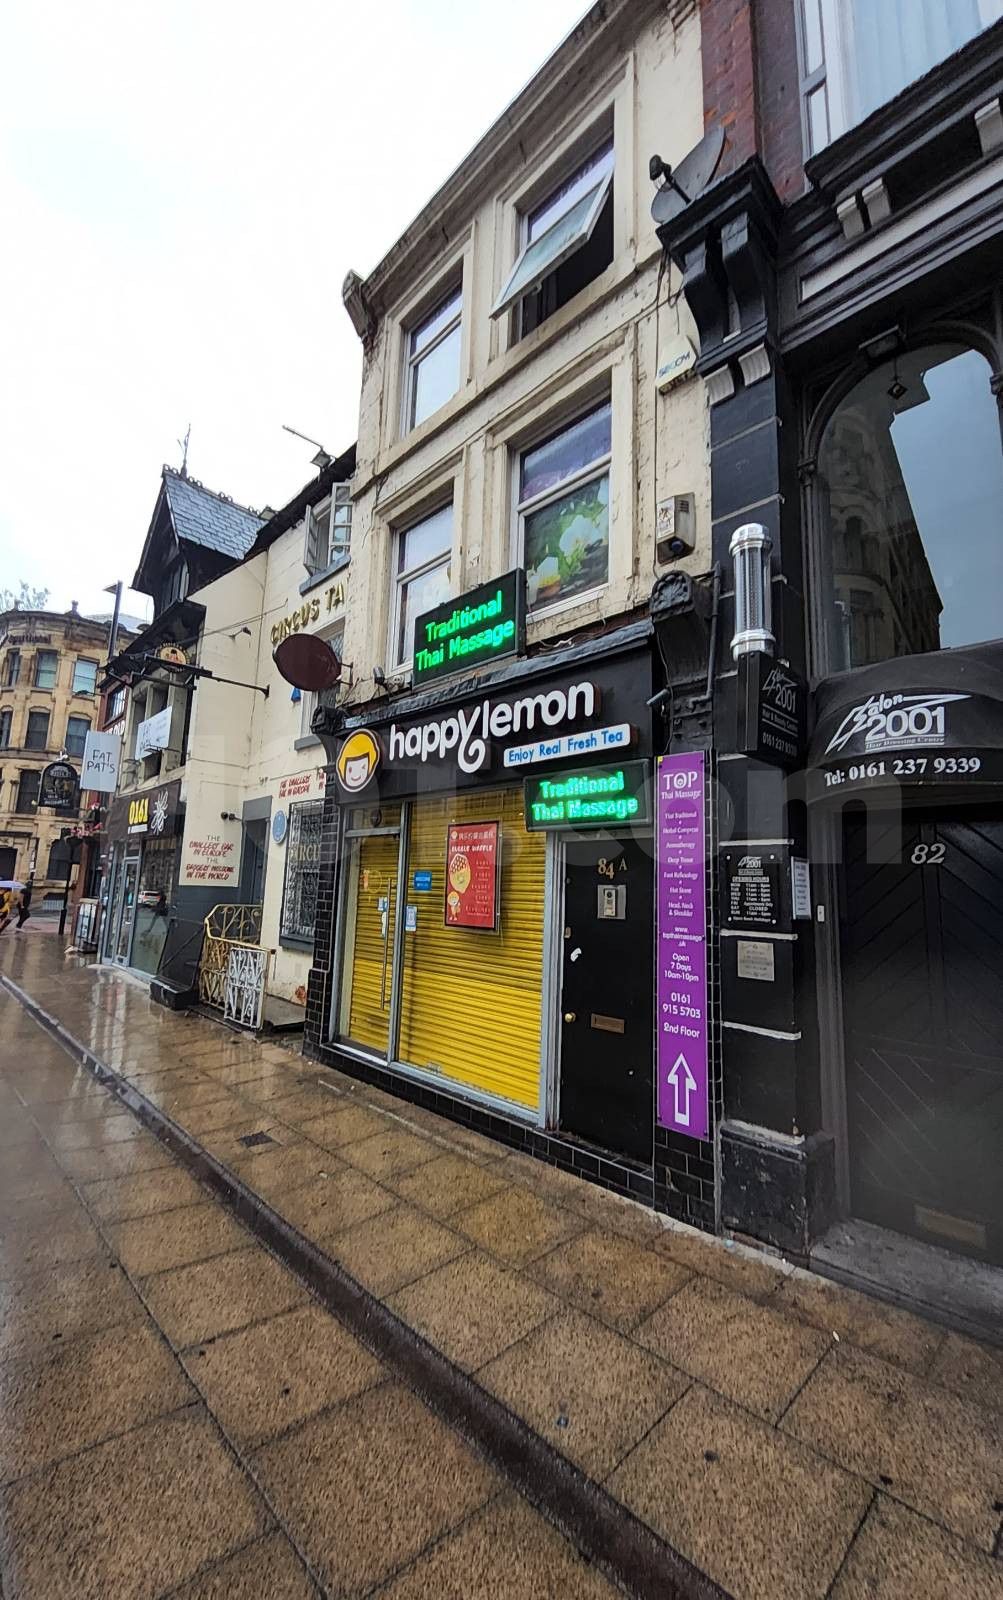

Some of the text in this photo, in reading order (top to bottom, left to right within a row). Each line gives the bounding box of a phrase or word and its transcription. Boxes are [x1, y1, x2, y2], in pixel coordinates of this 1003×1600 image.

[271, 598, 320, 644] CIRCUS
[425, 590, 502, 642] Traditional
[415, 617, 514, 671] Thai Massage
[775, 684, 796, 713] 2001
[865, 706, 944, 740] 2001
[92, 749, 113, 762] FAT
[508, 731, 623, 764] Enjoy Real Fresh Tea
[87, 761, 116, 774] PAT'S
[824, 757, 981, 786] Tel: 0161 237 9339
[540, 771, 625, 799] Traditional
[663, 771, 698, 790] TOP
[661, 790, 701, 800] Thai Massage
[129, 798, 149, 825] 0161
[532, 797, 638, 821] Thai Massage
[911, 843, 946, 864] 82
[598, 858, 627, 879] 84 A
[672, 953, 689, 962] Open
[677, 962, 691, 971] Days
[665, 970, 699, 982] 10am-10pm
[671, 992, 690, 1004] 0161
[663, 1004, 701, 1018] 915 5703
[664, 1022, 700, 1038] 2nd Floor
